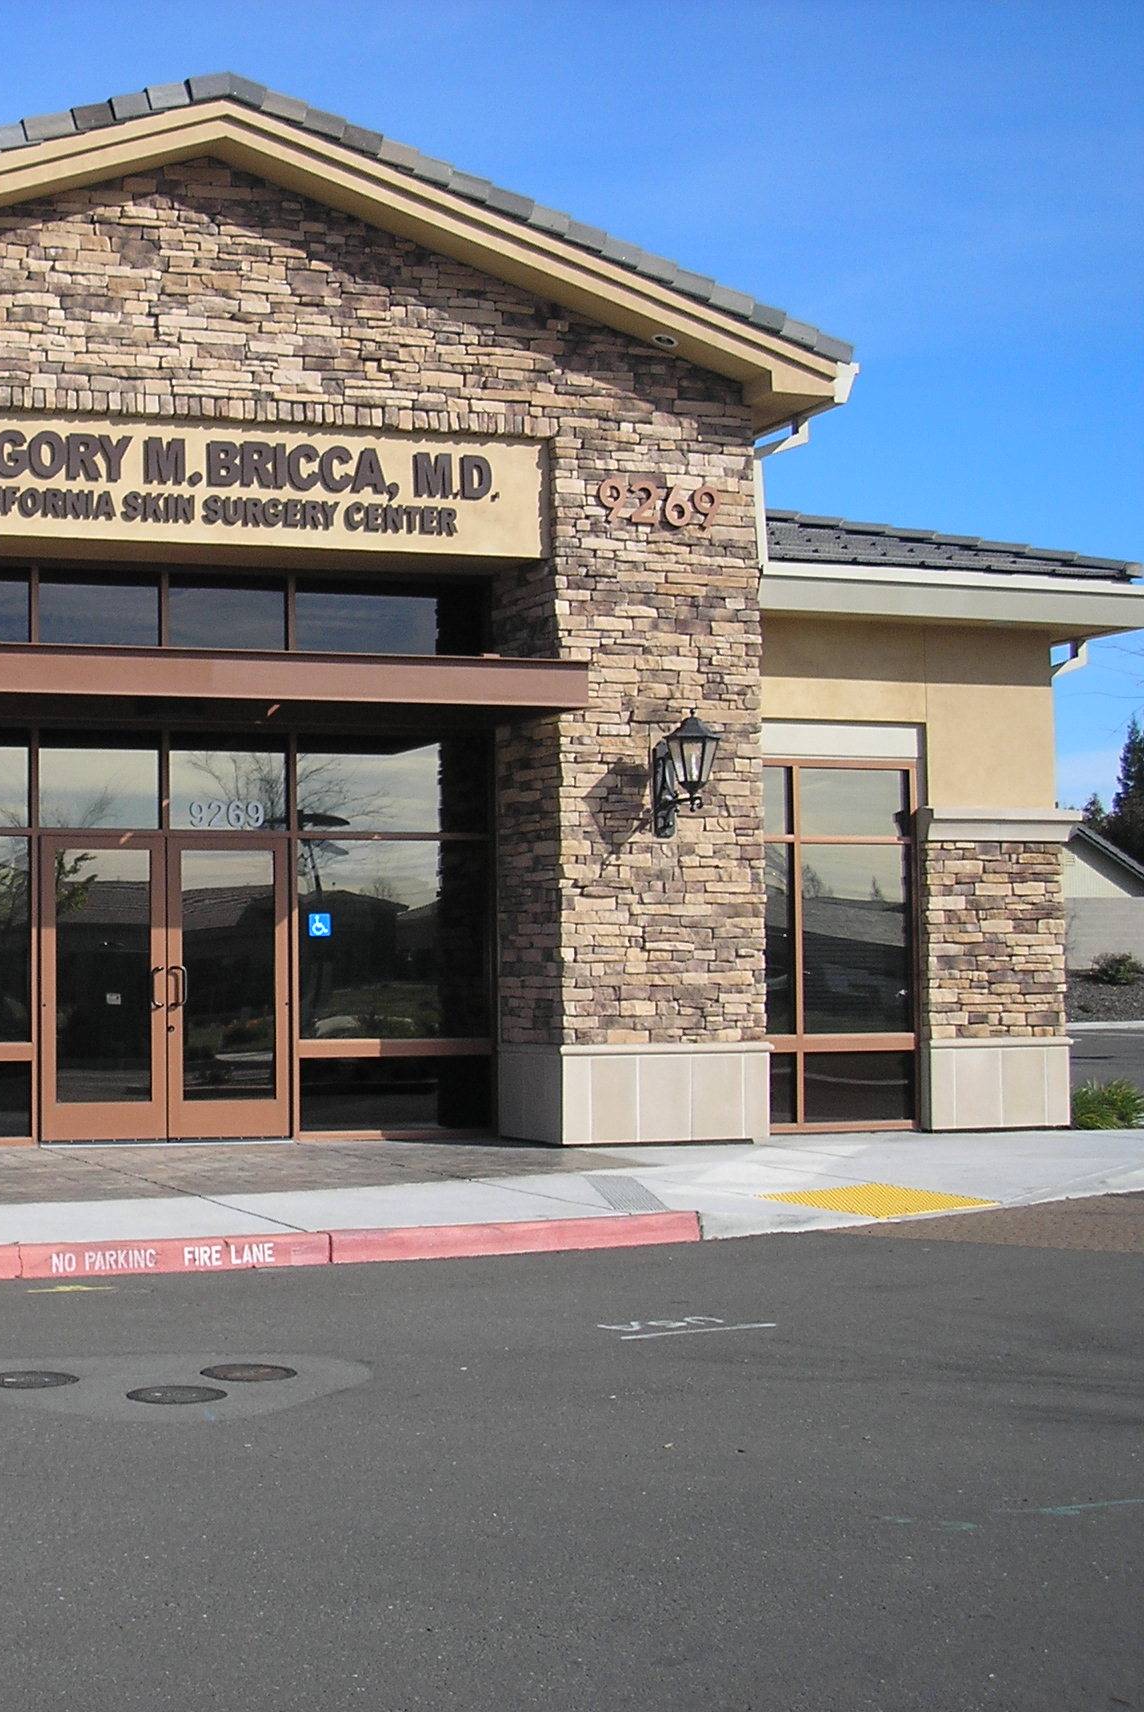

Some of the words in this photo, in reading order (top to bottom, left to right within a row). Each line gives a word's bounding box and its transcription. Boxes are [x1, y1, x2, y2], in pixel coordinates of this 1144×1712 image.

[120, 490, 195, 525] SKIN
[201, 494, 340, 531] SURGERY
[343, 501, 459, 537] CENTER
[598, 476, 722, 530] 9269
[189, 799, 265, 829] 9269
[51, 1252, 77, 1273] NO
[84, 1248, 157, 1271] PARKING
[183, 1245, 222, 1266] FIRE
[230, 1242, 275, 1265] LANE
